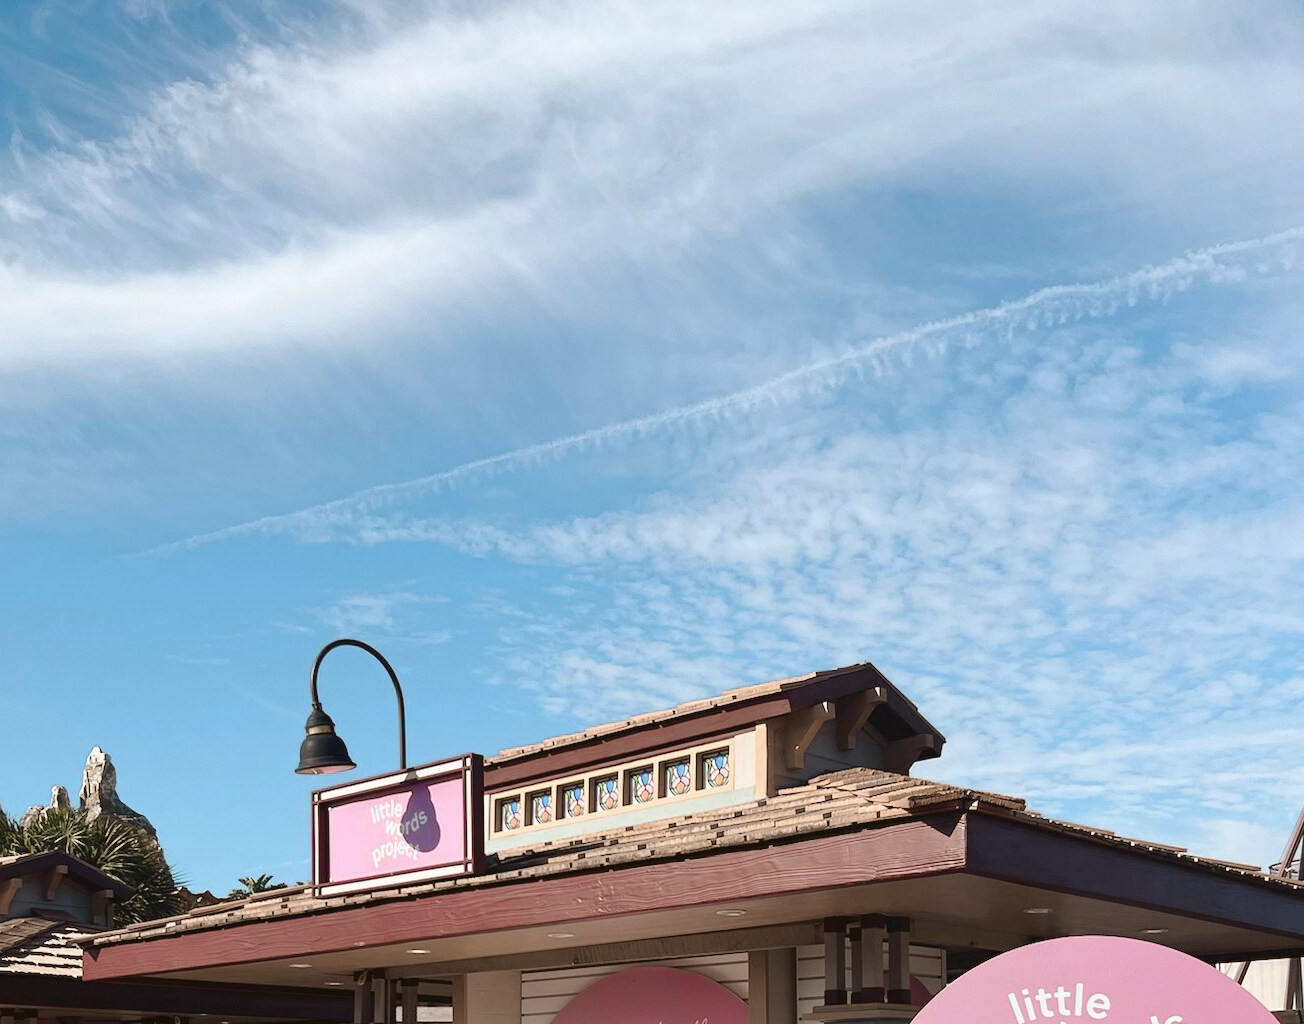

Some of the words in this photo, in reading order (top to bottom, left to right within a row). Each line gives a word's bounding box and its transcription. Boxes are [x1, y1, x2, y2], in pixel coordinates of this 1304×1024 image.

[370, 799, 403, 824] little
[385, 810, 428, 836] words
[372, 836, 420, 868] project
[1007, 983, 1111, 1024] little
